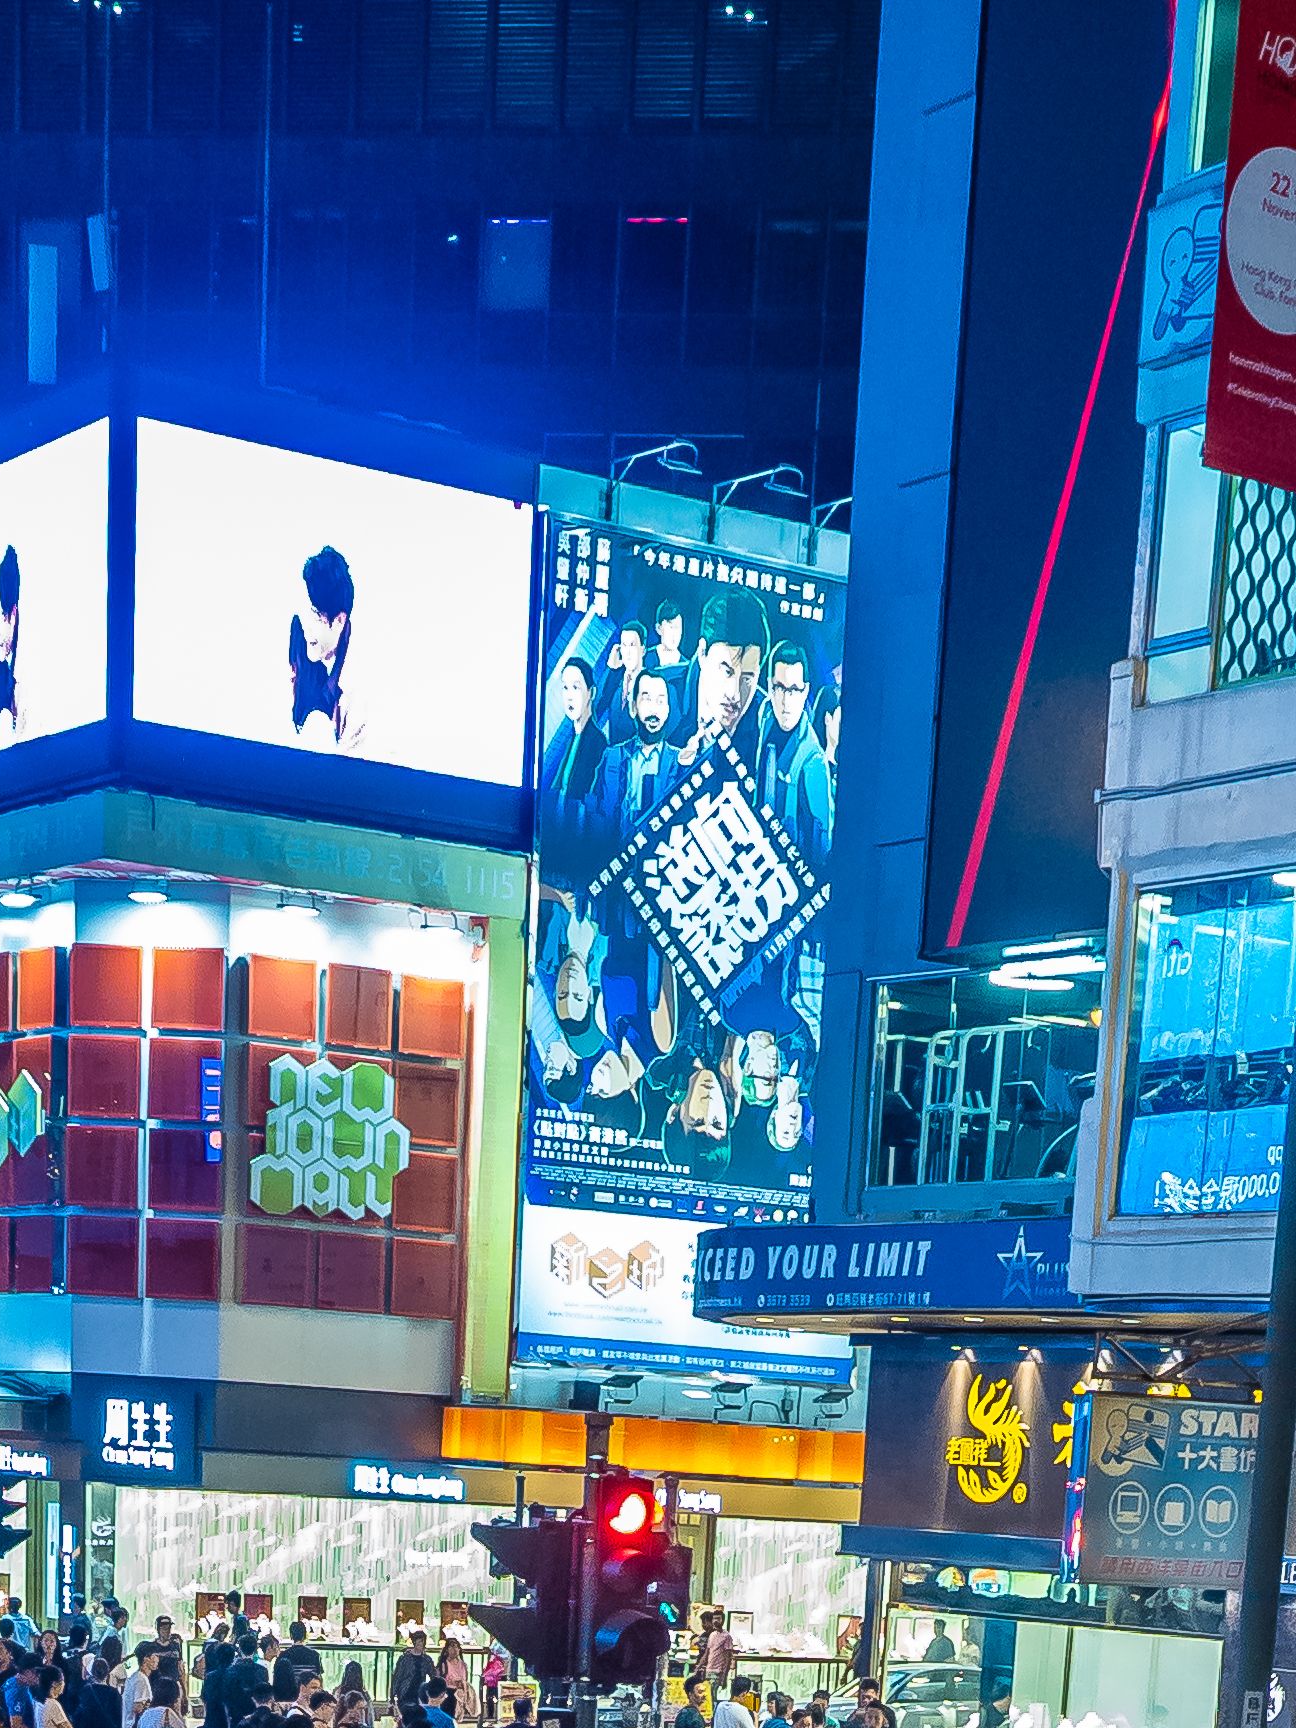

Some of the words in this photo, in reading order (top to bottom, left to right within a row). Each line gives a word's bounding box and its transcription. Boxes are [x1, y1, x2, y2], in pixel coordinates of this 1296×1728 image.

[1269, 171, 1291, 198] 22
[465, 864, 515, 899] 1115
[269, 1053, 396, 1123] NEW
[266, 1105, 411, 1175] TOWN
[250, 1154, 392, 1221] MALL
[768, 1243, 837, 1282] YOUR
[849, 1241, 932, 1279] LIMIT
[103, 1398, 175, 1449] 周生生
[1179, 1408, 1260, 1439] STAR
